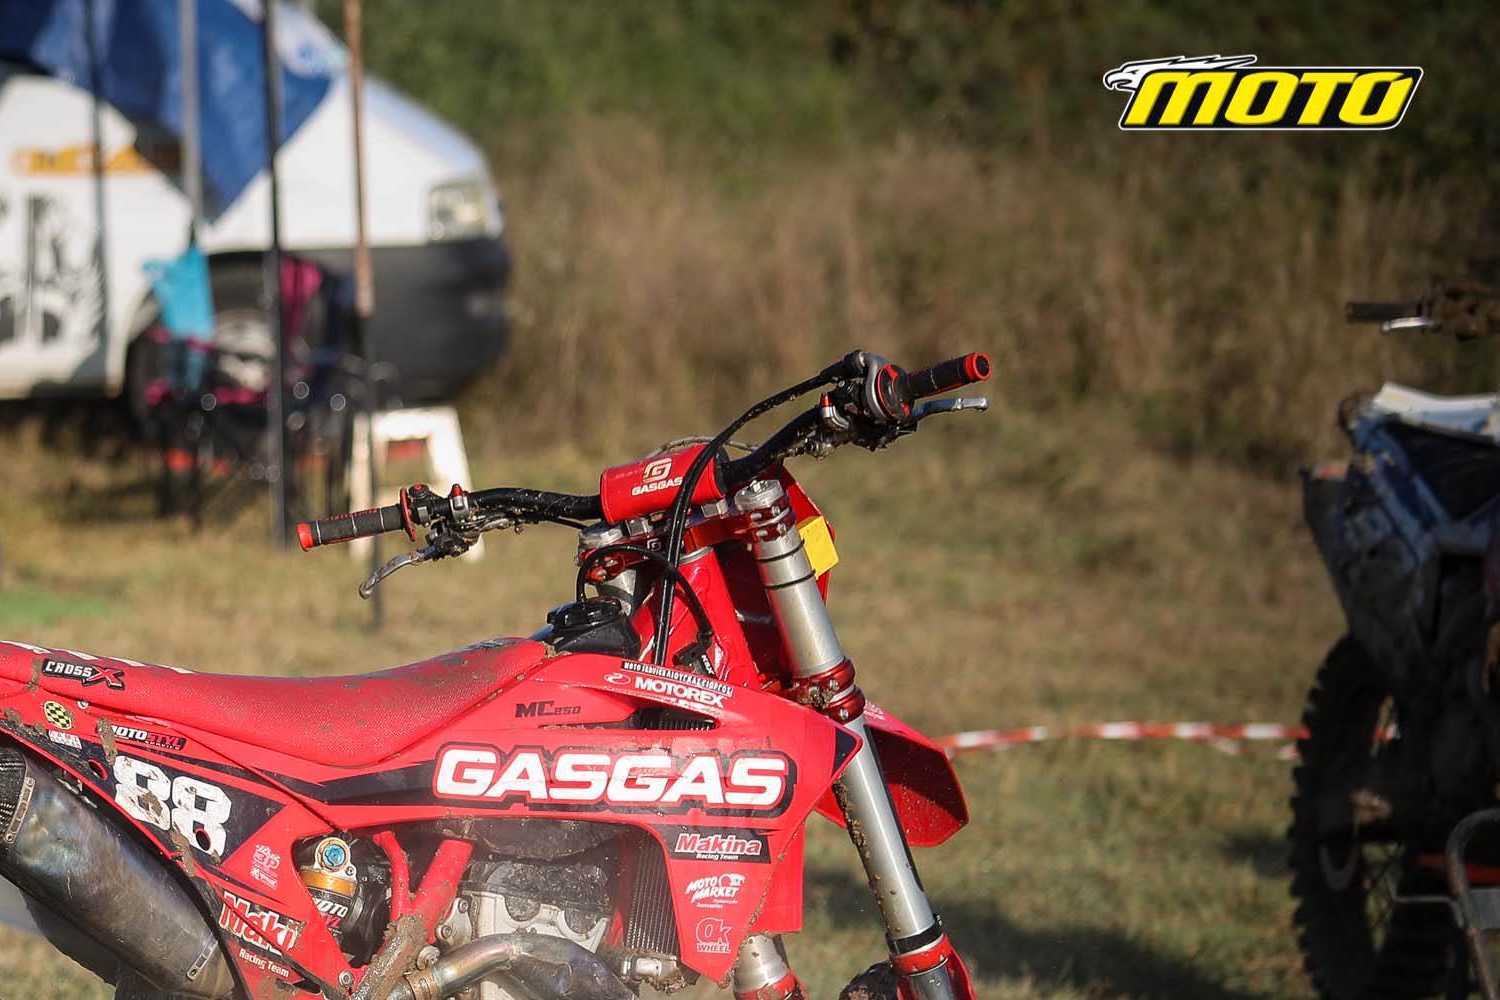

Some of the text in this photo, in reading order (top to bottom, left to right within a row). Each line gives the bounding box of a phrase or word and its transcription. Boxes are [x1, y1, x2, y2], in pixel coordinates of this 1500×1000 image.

[631, 476, 684, 497] GASGAS
[635, 676, 724, 708] MOTOREX
[100, 725, 182, 747] OTOSTYL
[437, 748, 787, 806] GASGAS
[113, 755, 232, 857] 88
[675, 833, 762, 855] Makina
[696, 853, 719, 861] Racing
[685, 876, 717, 894] MOTO
[691, 886, 739, 903] MARKET
[697, 943, 732, 953] WHEEL
[239, 948, 290, 978] Racing Team
